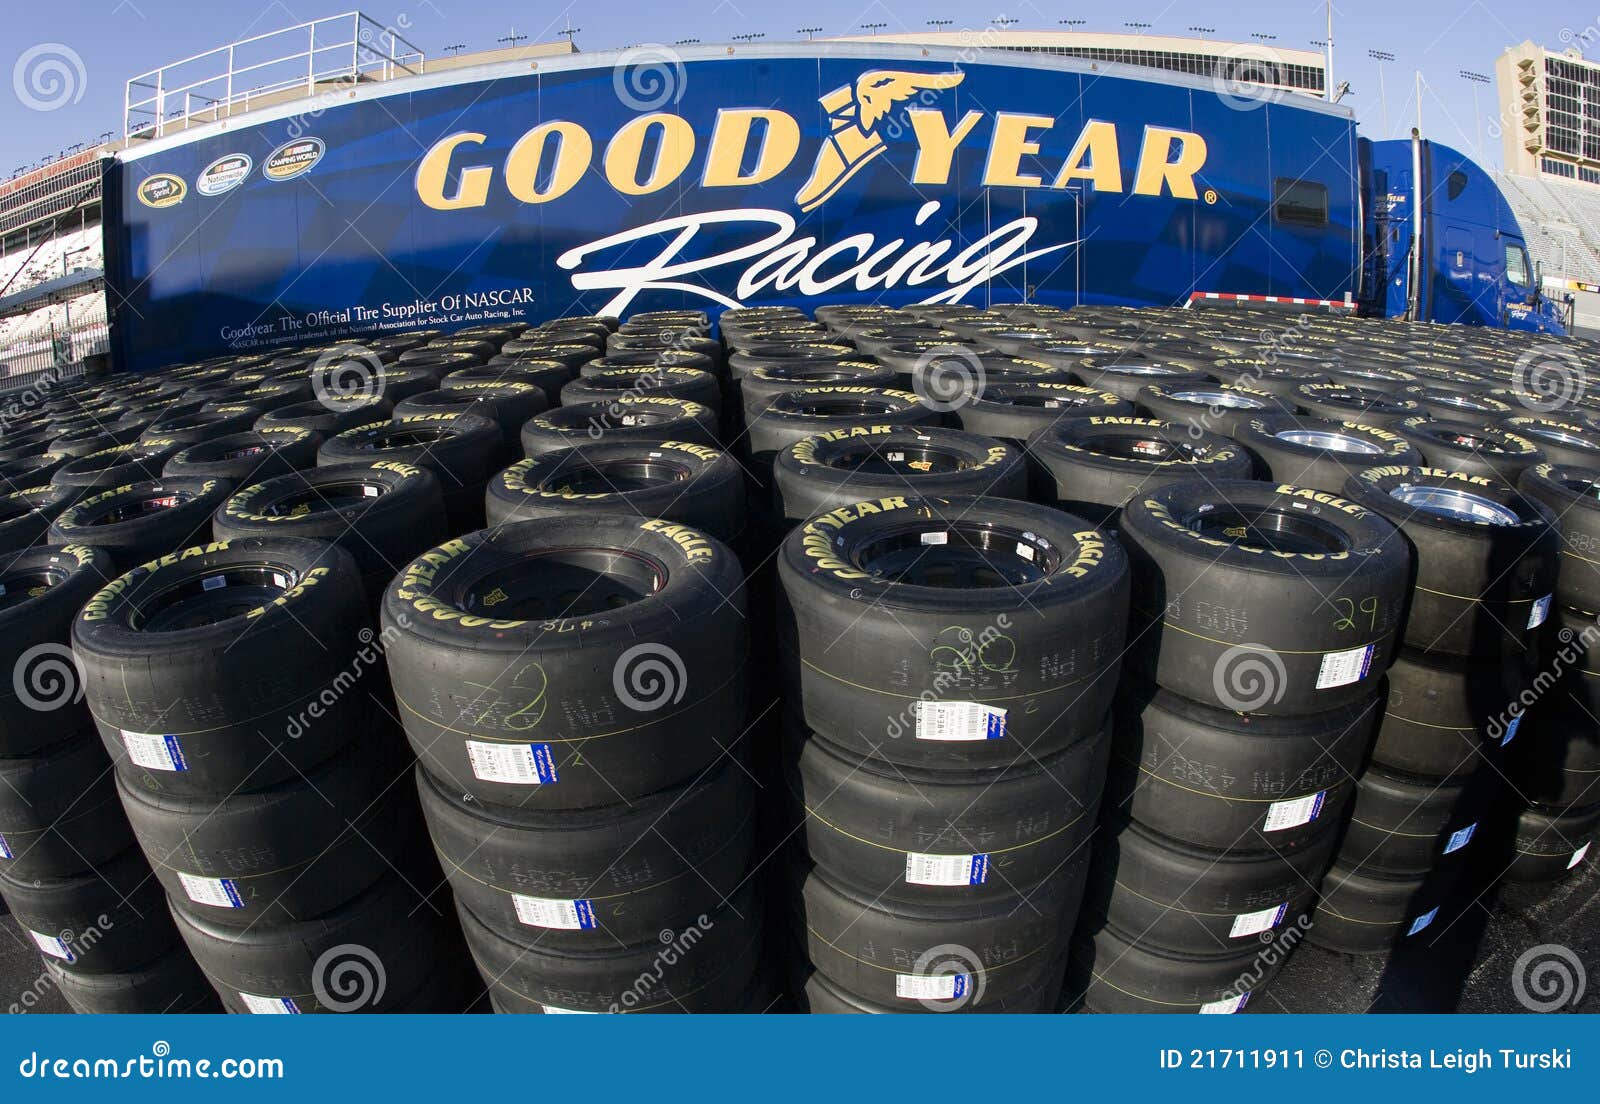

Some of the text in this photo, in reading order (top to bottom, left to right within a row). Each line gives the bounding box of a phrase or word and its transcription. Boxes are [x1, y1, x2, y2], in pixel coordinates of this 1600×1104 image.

[270, 151, 318, 168] CAMPING WORLD
[208, 170, 244, 184] Nationwide
[153, 187, 171, 199] Sprint
[556, 200, 1087, 317] Racing
[279, 316, 303, 331] The
[306, 307, 351, 327] Official
[353, 305, 379, 321] Tire
[382, 300, 438, 319] Supplier
[441, 294, 461, 311] Of
[465, 287, 535, 309] NASCAR
[350, 323, 377, 333] National
[378, 320, 417, 330] Association
[418, 317, 428, 326] for
[428, 315, 449, 325] Stock
[450, 313, 463, 322] Car
[465, 311, 483, 321] Auto
[484, 309, 511, 319] Racing,
[512, 307, 527, 316] Inc.
[804, 386, 877, 394] GOOD
[1089, 415, 1165, 427] EAGLE
[817, 424, 892, 443] YEAR
[660, 440, 721, 462] EAGLE
[1418, 466, 1493, 487] YEAR
[1275, 483, 1367, 515] EAGLE
[820, 495, 909, 532] YEAR
[639, 518, 713, 563] EAGLE
[526, 751, 537, 776] EAGLE
